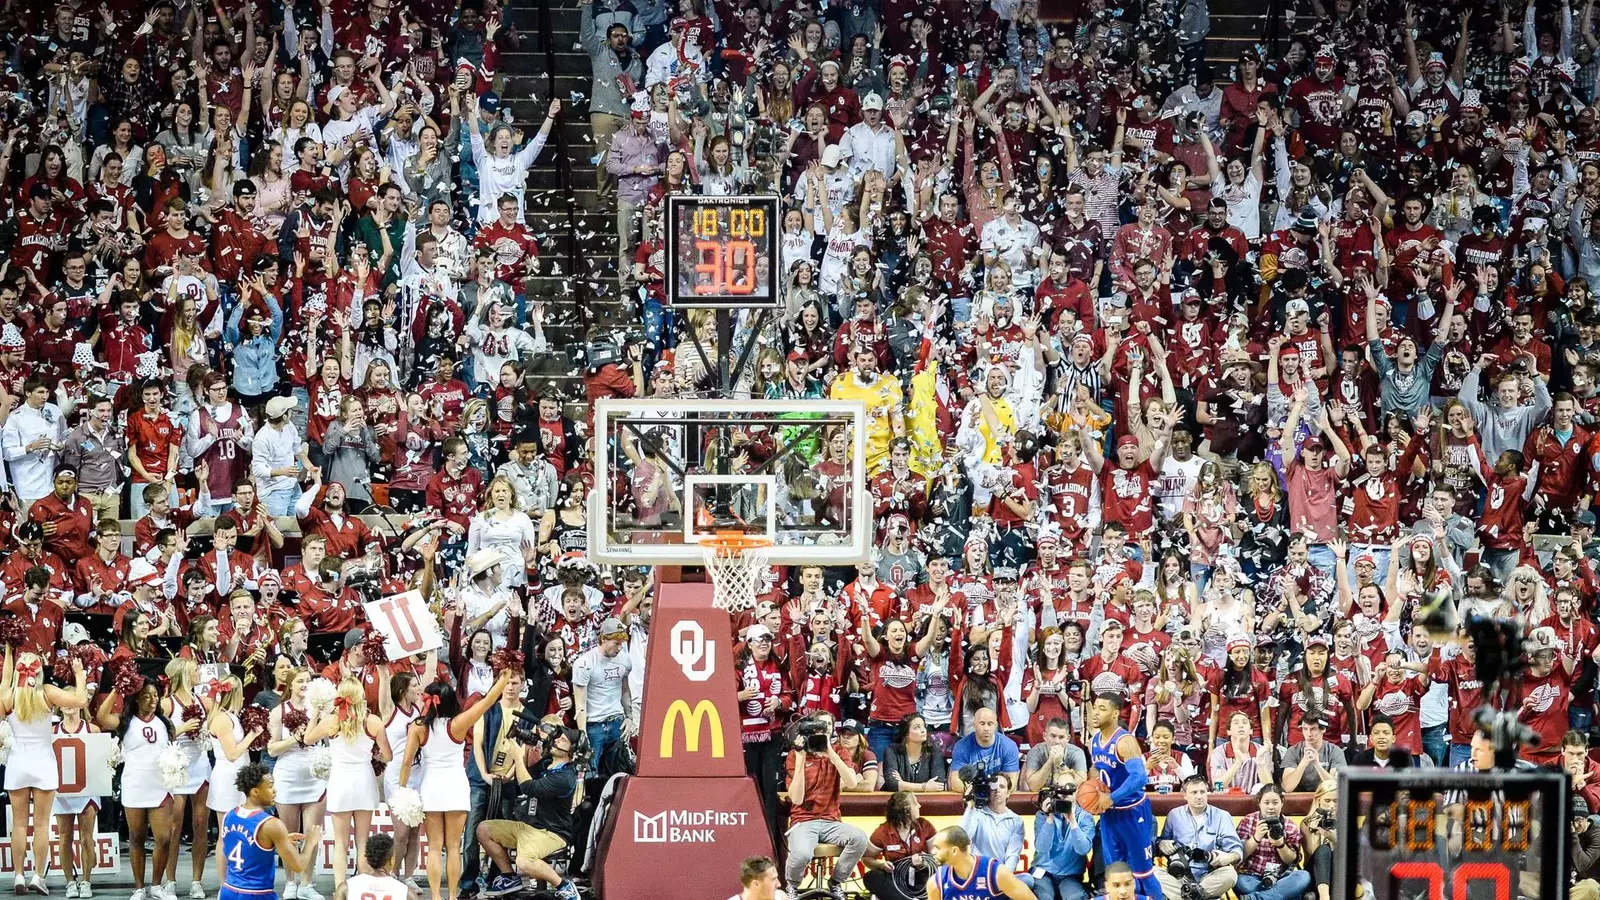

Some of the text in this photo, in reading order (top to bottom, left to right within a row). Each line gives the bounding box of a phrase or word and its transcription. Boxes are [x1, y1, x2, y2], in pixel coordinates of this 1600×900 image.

[32, 251, 44, 270] 4
[694, 240, 756, 295] 30
[217, 440, 235, 461] 18
[1061, 496, 1075, 517] 3
[379, 596, 424, 653] U
[670, 619, 716, 682] OU
[142, 726, 157, 744] OU
[228, 839, 245, 871] 4
